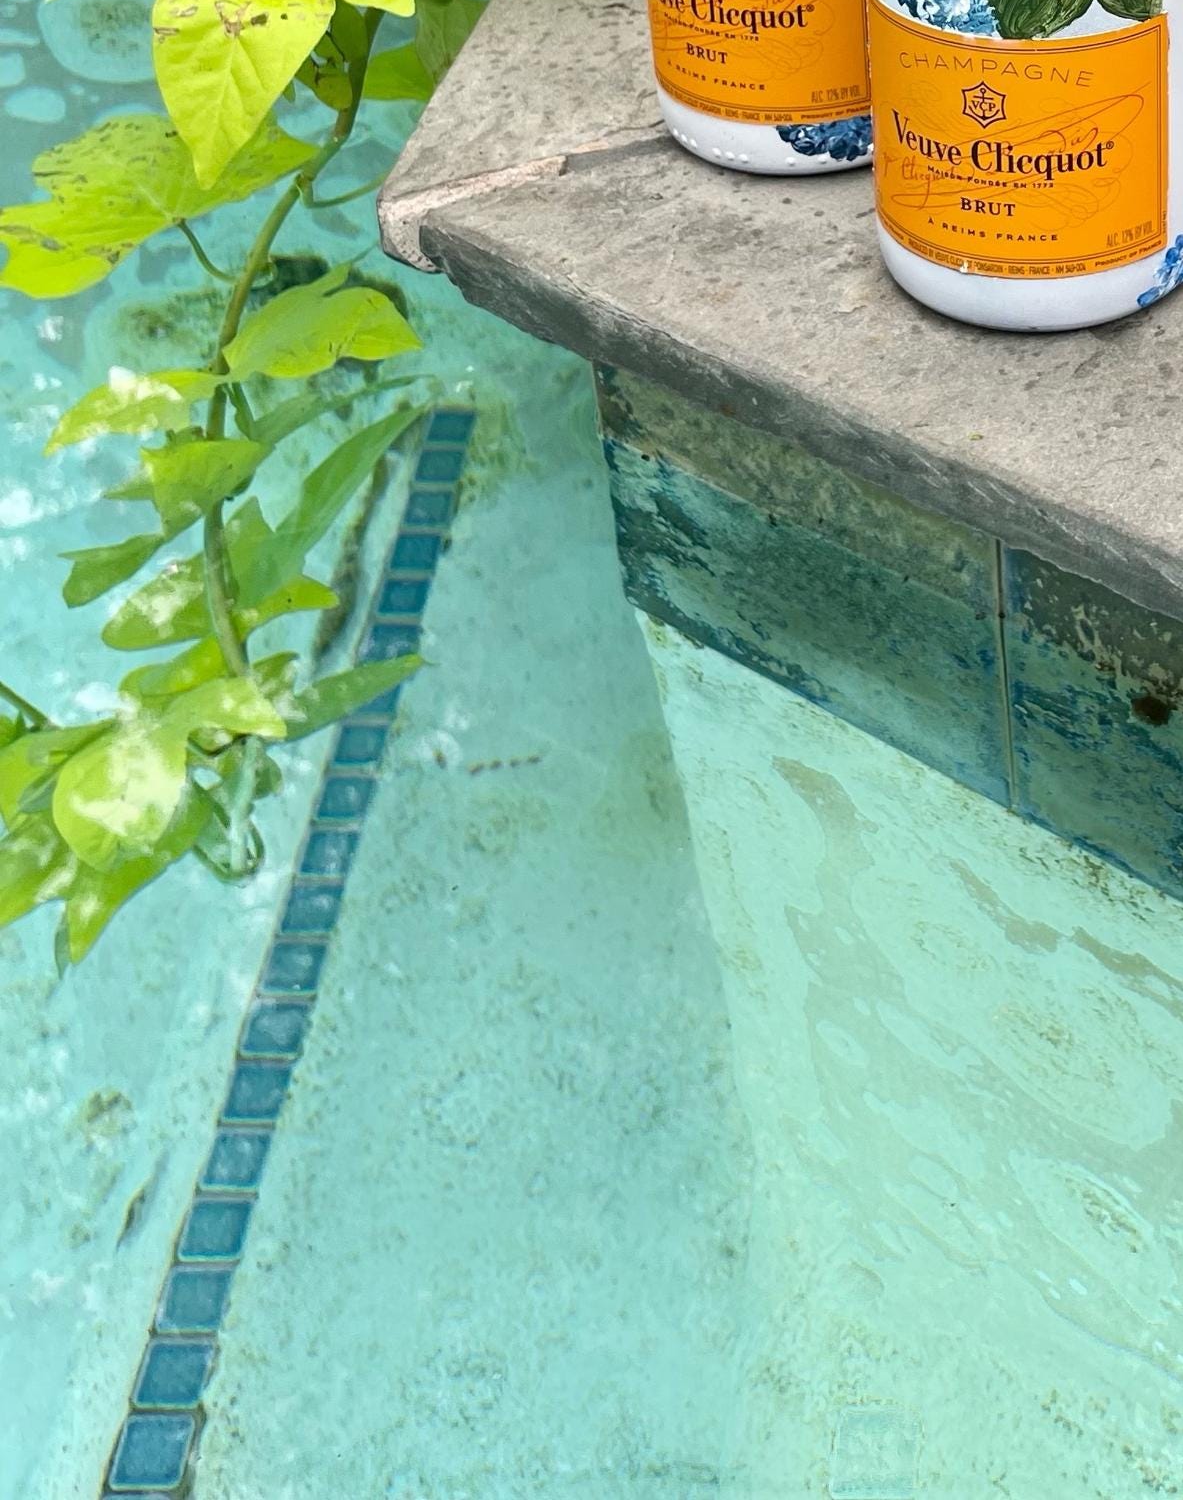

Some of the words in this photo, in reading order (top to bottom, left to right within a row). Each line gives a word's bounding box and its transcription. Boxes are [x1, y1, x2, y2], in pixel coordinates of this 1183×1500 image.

[686, 42, 728, 64] BRUT
[676, 64, 706, 81] REIMS
[714, 78, 766, 91] FRANCE
[899, 51, 1095, 88] CHAMPAGNE
[971, 99, 997, 113] VCP
[891, 108, 962, 166] Veuve
[927, 165, 964, 182] MAISON
[960, 196, 1016, 217] BRUT
[942, 222, 986, 239] REIMS
[996, 232, 1059, 242] FRANCE
[1095, 254, 1128, 267] PRODUCT
[1129, 250, 1138, 258] OF
